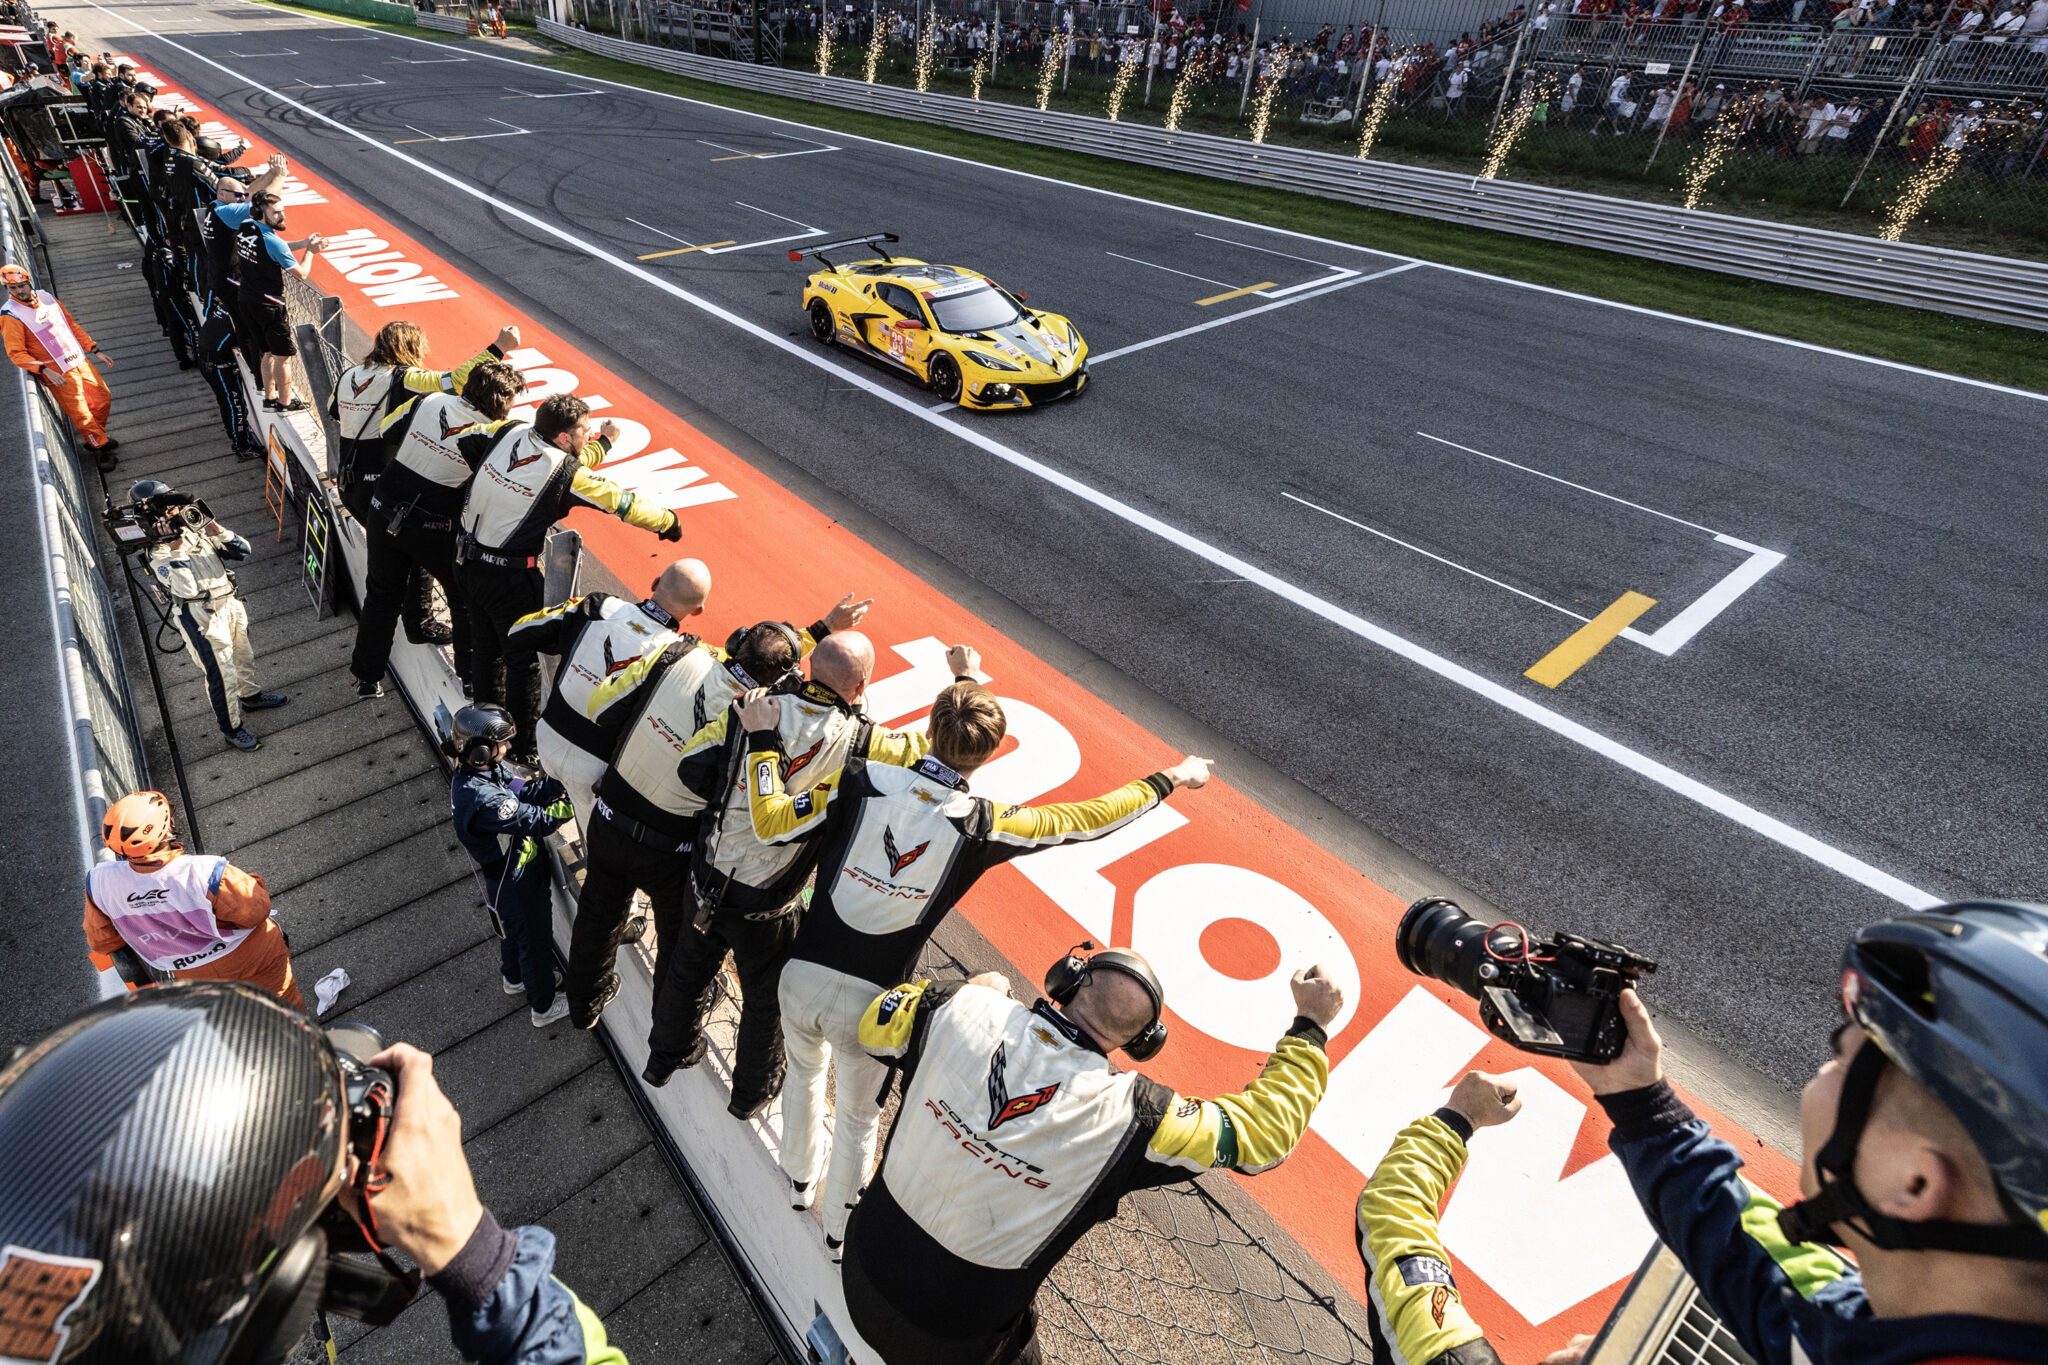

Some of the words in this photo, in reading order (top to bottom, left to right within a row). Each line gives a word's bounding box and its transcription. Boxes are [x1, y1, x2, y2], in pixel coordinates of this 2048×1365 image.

[320, 228, 461, 307] MOTUL
[818, 281, 832, 291] Mobil
[831, 286, 838, 294] 1
[891, 331, 904, 353] 33
[232, 391, 244, 432] ALPINE
[409, 431, 467, 466] RACING
[482, 463, 536, 498] RACING
[488, 463, 533, 492] CORVETTE
[480, 552, 509, 567] MRTC
[571, 663, 601, 687] RAC
[578, 664, 603, 683] CORV
[647, 715, 685, 752] RAC
[657, 717, 688, 746] CORV
[842, 867, 931, 900] RACING
[853, 866, 926, 893] CORVETTE
[127, 889, 170, 902] WEC
[925, 1097, 1052, 1190] RACING
[938, 1099, 1045, 1175] CORVETTE
